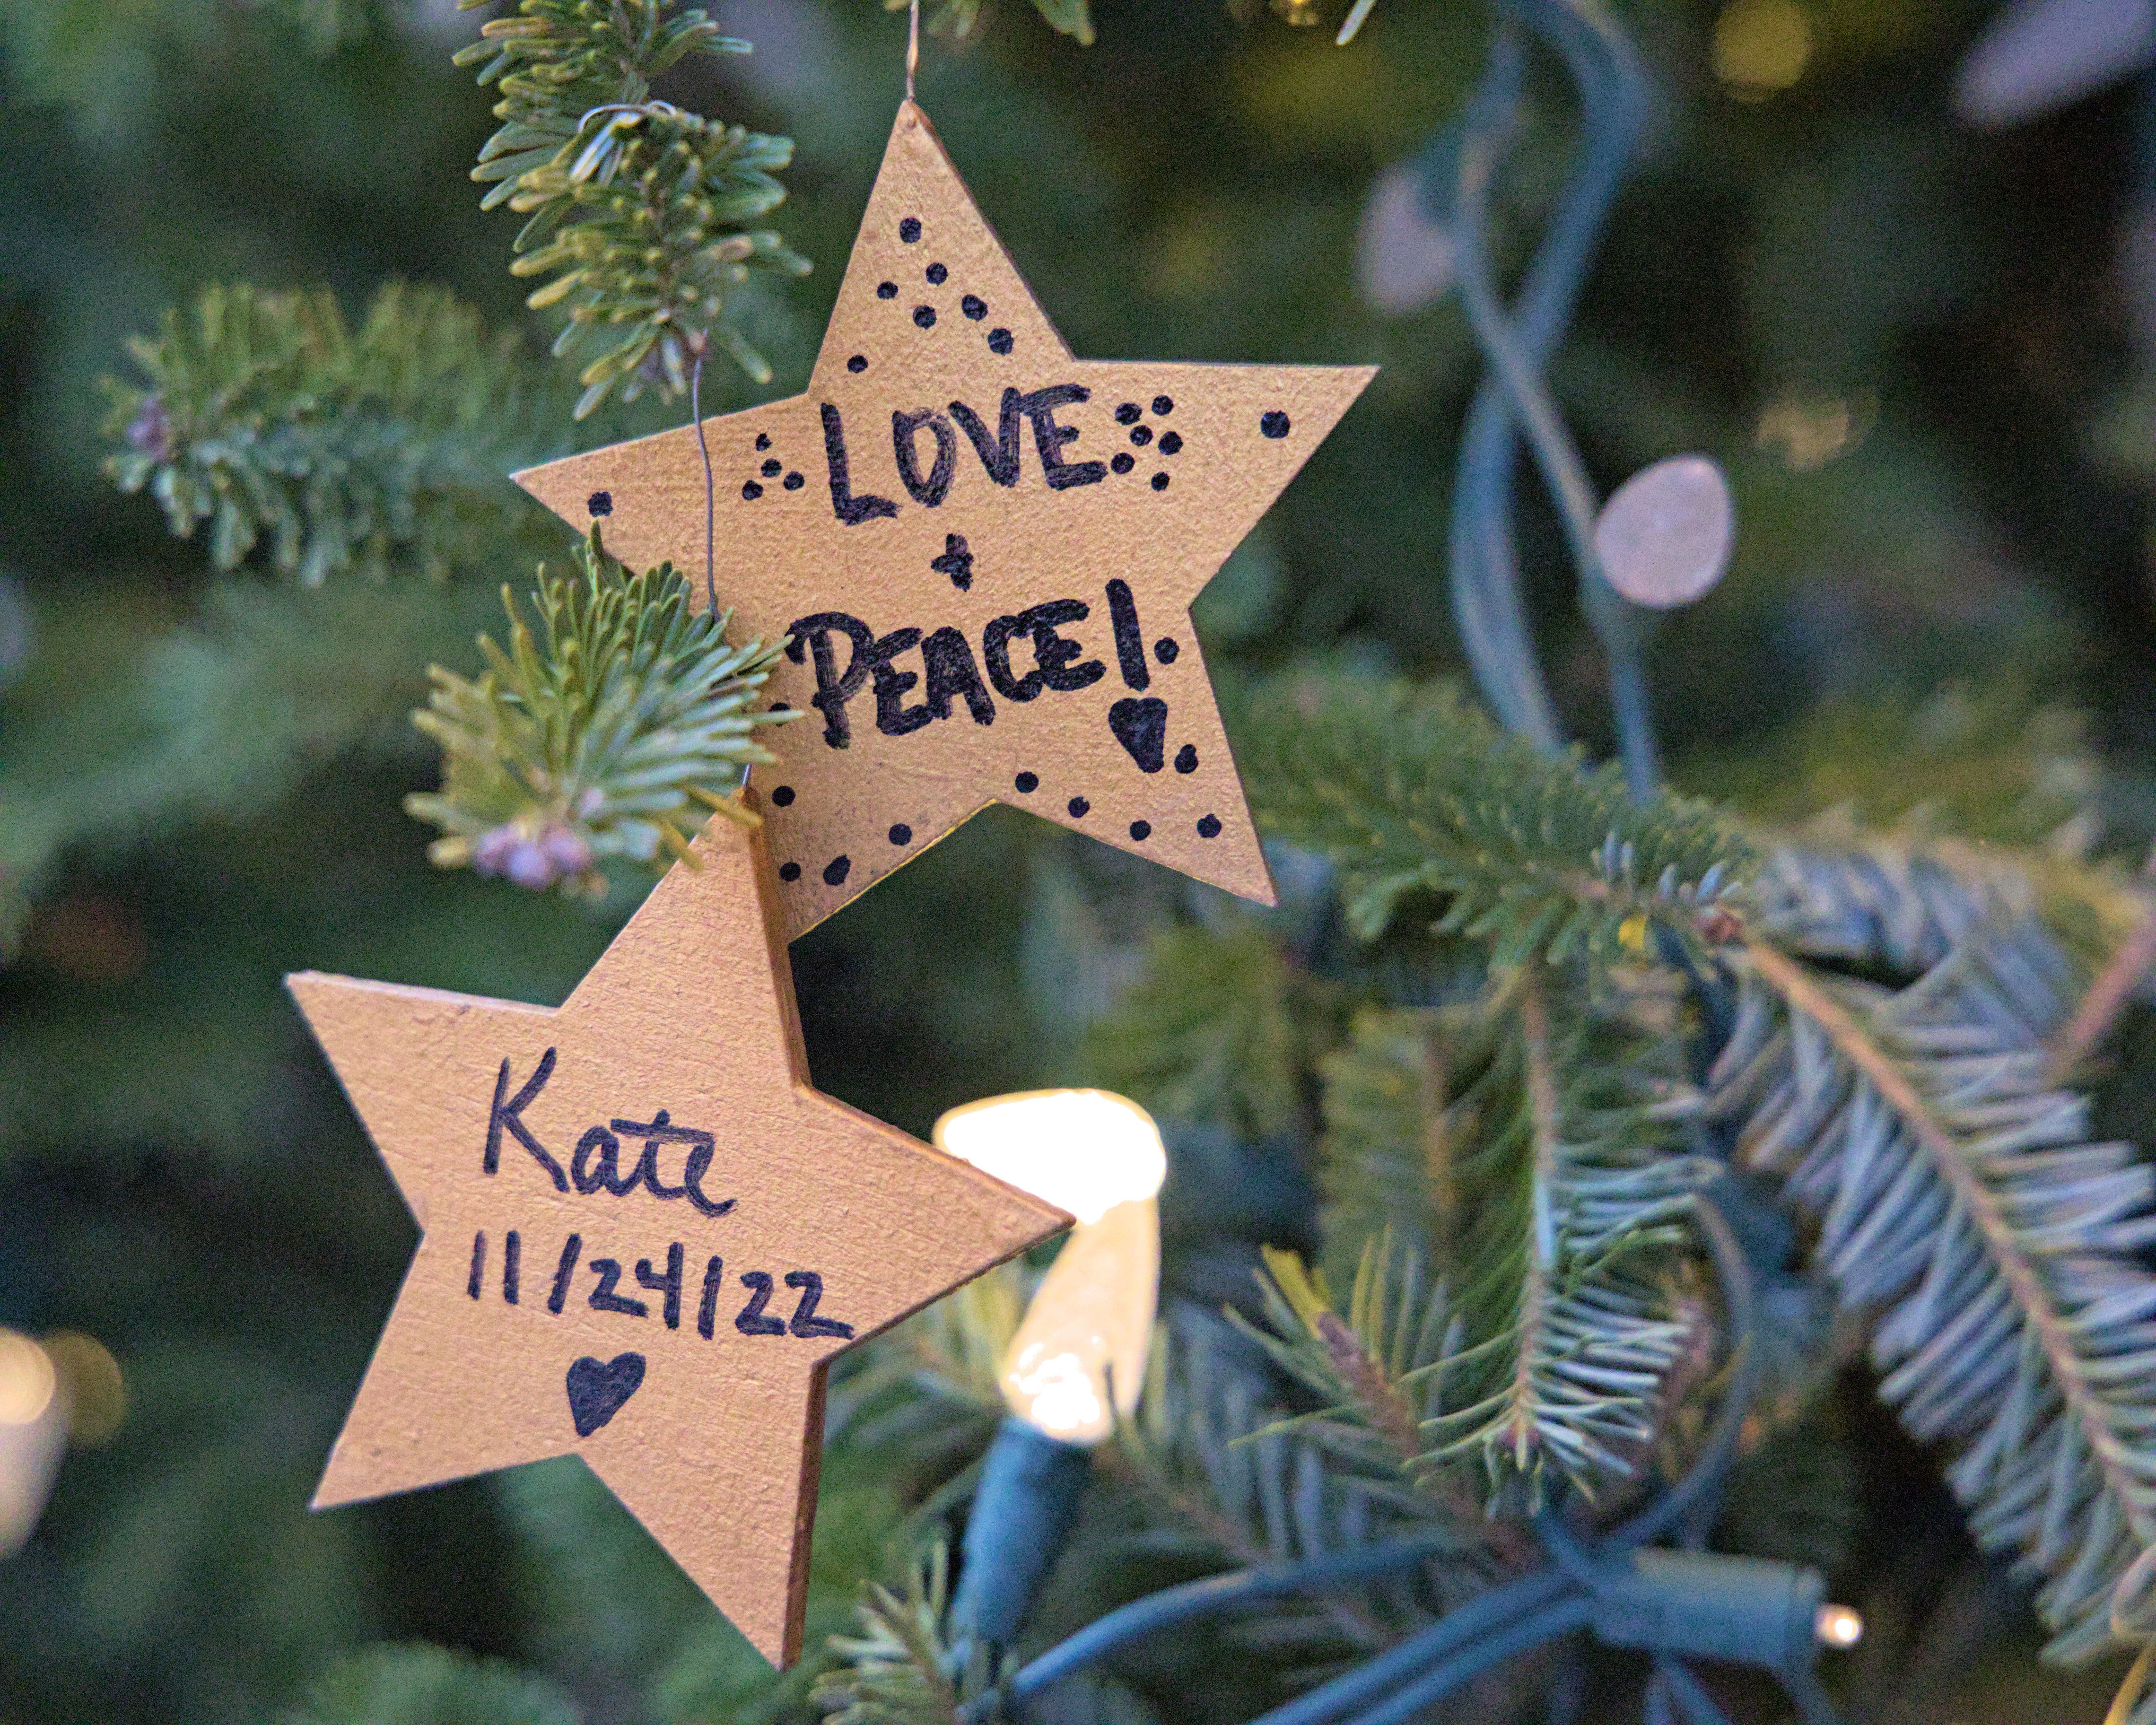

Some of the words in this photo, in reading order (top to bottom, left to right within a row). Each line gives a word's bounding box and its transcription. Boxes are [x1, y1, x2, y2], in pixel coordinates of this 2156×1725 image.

[821, 383, 1108, 526] LOVE
[484, 1047, 739, 1218] Kate
[467, 1229, 855, 1340] 11/24/22
